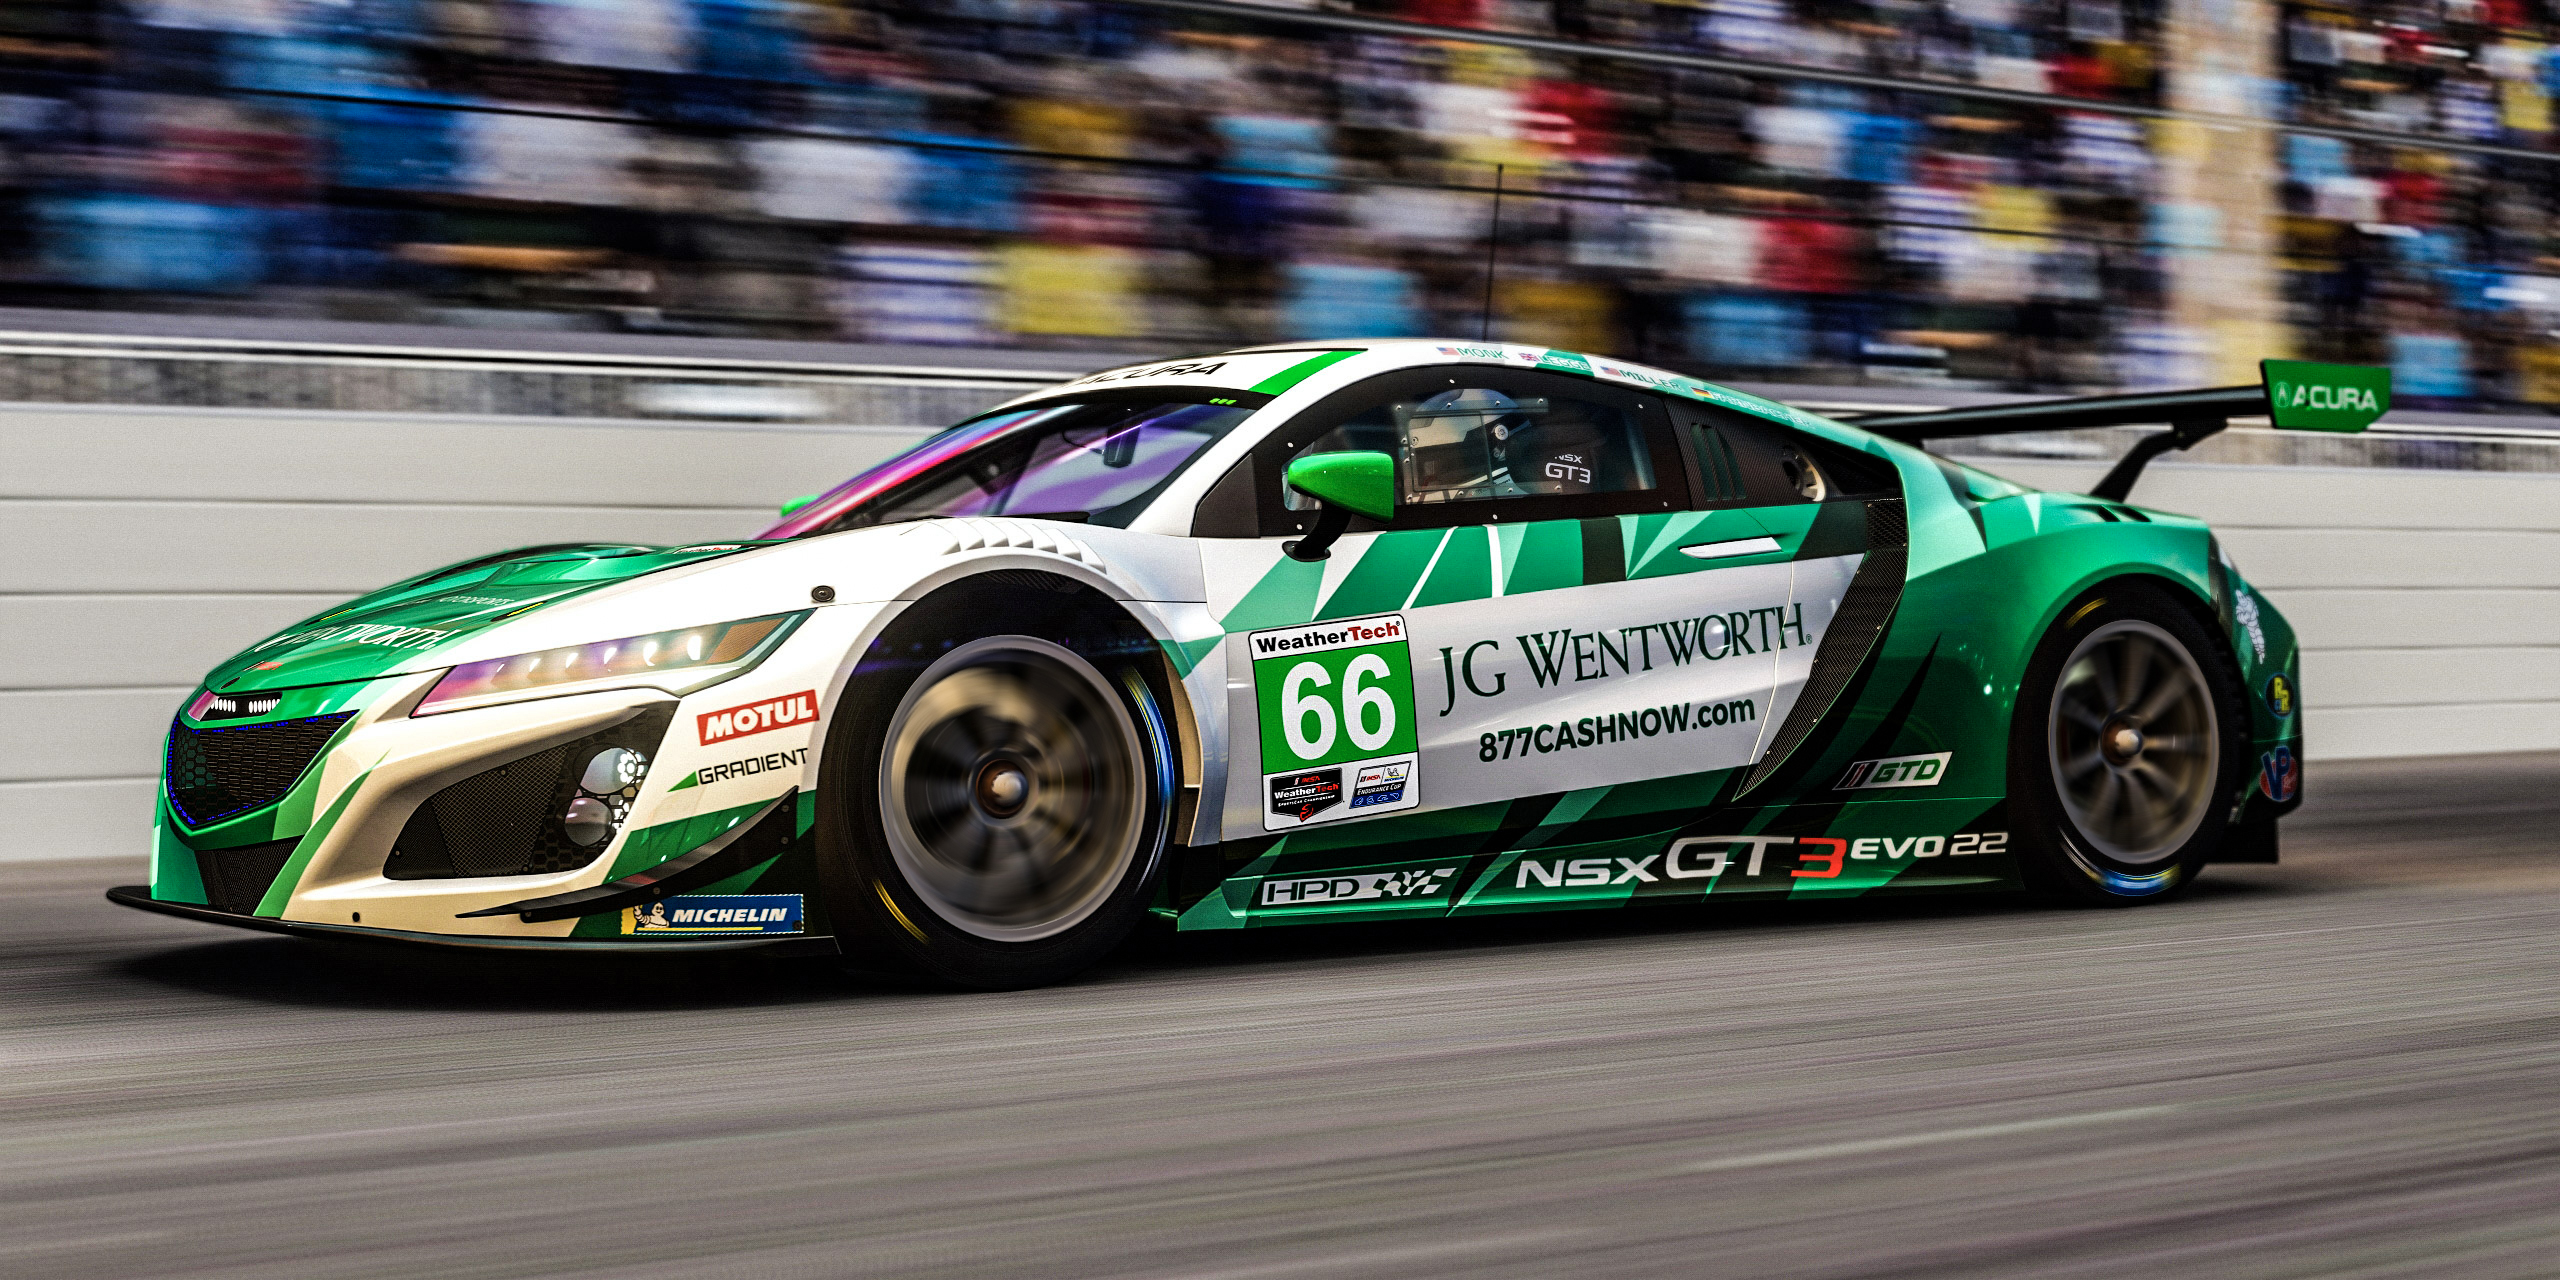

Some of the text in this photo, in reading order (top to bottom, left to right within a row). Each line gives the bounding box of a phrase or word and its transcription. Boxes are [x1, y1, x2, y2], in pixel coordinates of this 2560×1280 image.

[1456, 347, 1509, 360] MONK
[2292, 384, 2378, 412] ACURA
[1545, 462, 1591, 484] GT3
[1440, 640, 1507, 717] JG
[705, 696, 813, 741] MOTUL
[1281, 653, 1396, 761] 66
[1479, 699, 1756, 763] 877CASHNOW.com
[698, 748, 808, 785] GRADIENT
[1870, 759, 1941, 783] GTD
[1516, 832, 2009, 888] NSX GT3 EVO 22
[1266, 878, 1360, 903] HPD
[672, 908, 788, 922] MICHELIN
